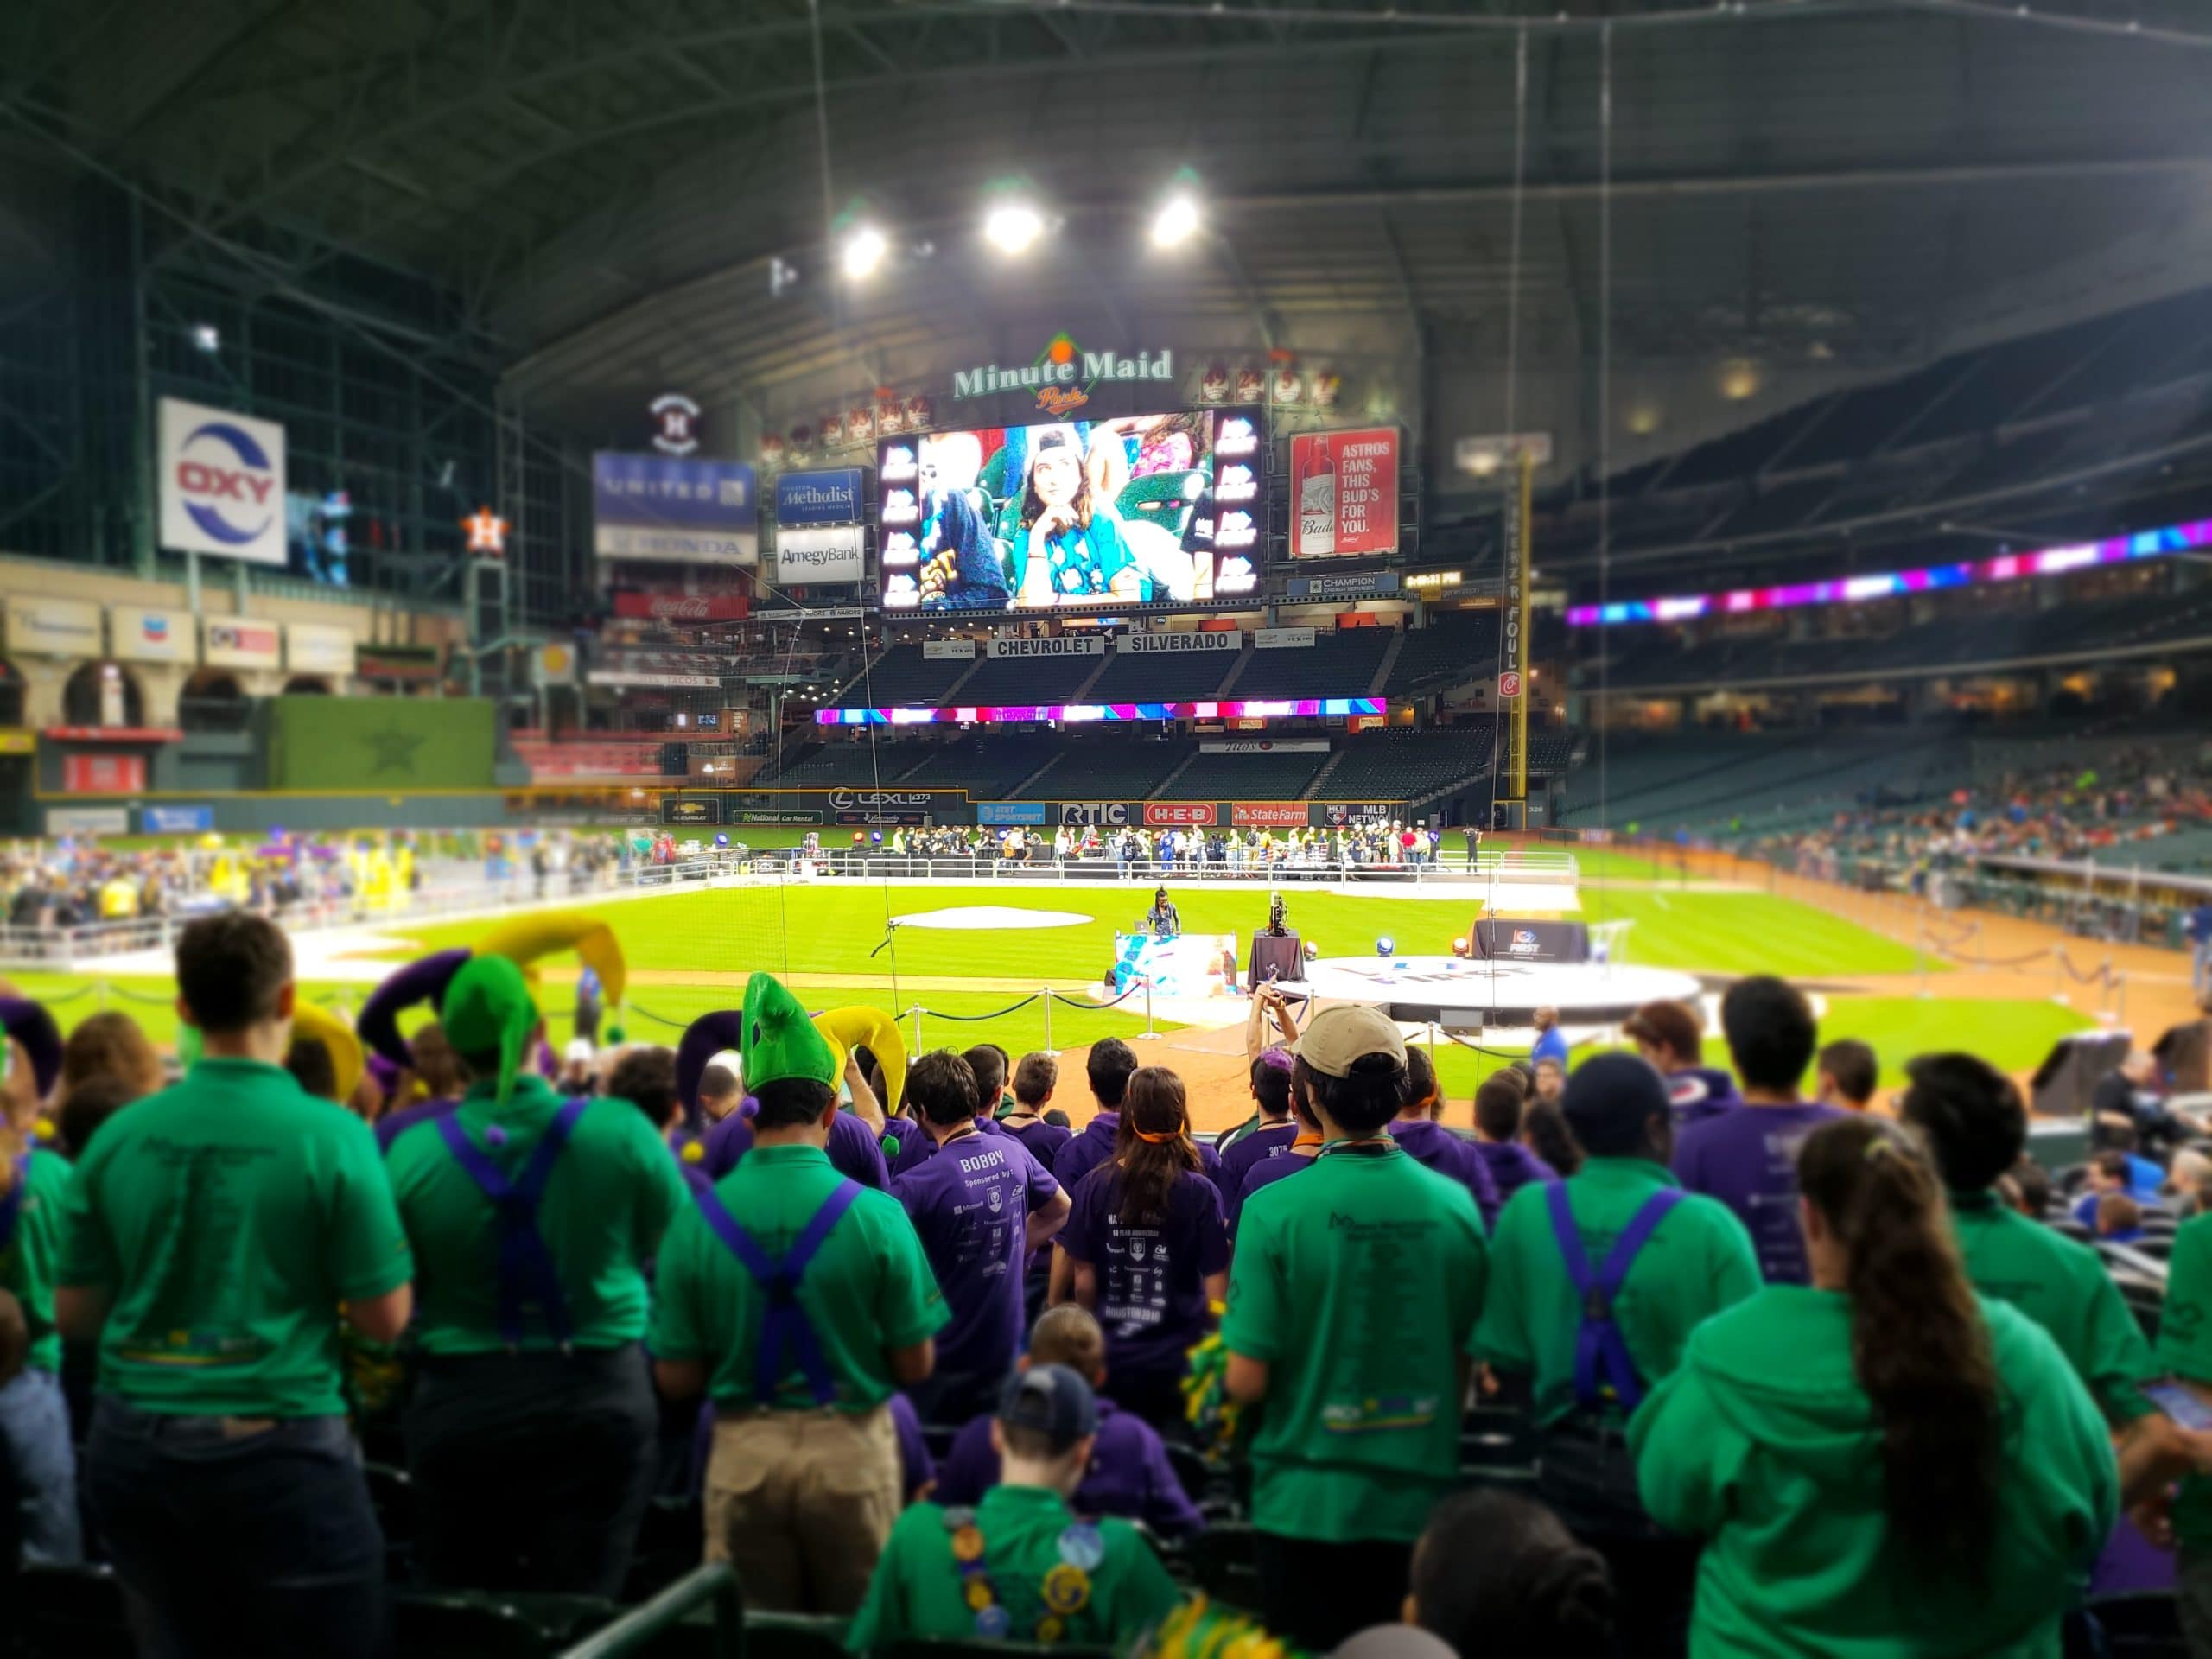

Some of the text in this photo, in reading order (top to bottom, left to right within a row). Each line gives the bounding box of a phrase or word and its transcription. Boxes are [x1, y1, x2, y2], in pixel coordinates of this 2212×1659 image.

[953, 350, 1173, 398] Minute Maid
[1342, 442, 1390, 458] ASTROS
[1342, 458, 1376, 473] FANS,
[178, 461, 274, 507] OXY
[607, 477, 712, 500] UNITED
[1342, 474, 1370, 488] THIS
[782, 486, 854, 505] Methodist
[1342, 488, 1380, 504] BUD'S
[1342, 505, 1366, 519] FOR
[471, 515, 503, 548] H
[1341, 519, 1370, 534] YOU.
[639, 539, 742, 556] HONDA
[1324, 577, 1376, 587] CHAMPION
[1442, 588, 1480, 597] generation
[650, 597, 709, 618] Coca-Cola
[997, 639, 1094, 656] CHEVROLET
[1132, 633, 1228, 652] SILVERADO
[1062, 804, 1126, 823] RTIC
[1363, 805, 1387, 815] MLB
[1510, 944, 1541, 952] FIRST
[960, 1149, 1004, 1173] BOBBY
[964, 1168, 1014, 1188] Sponsored by:
